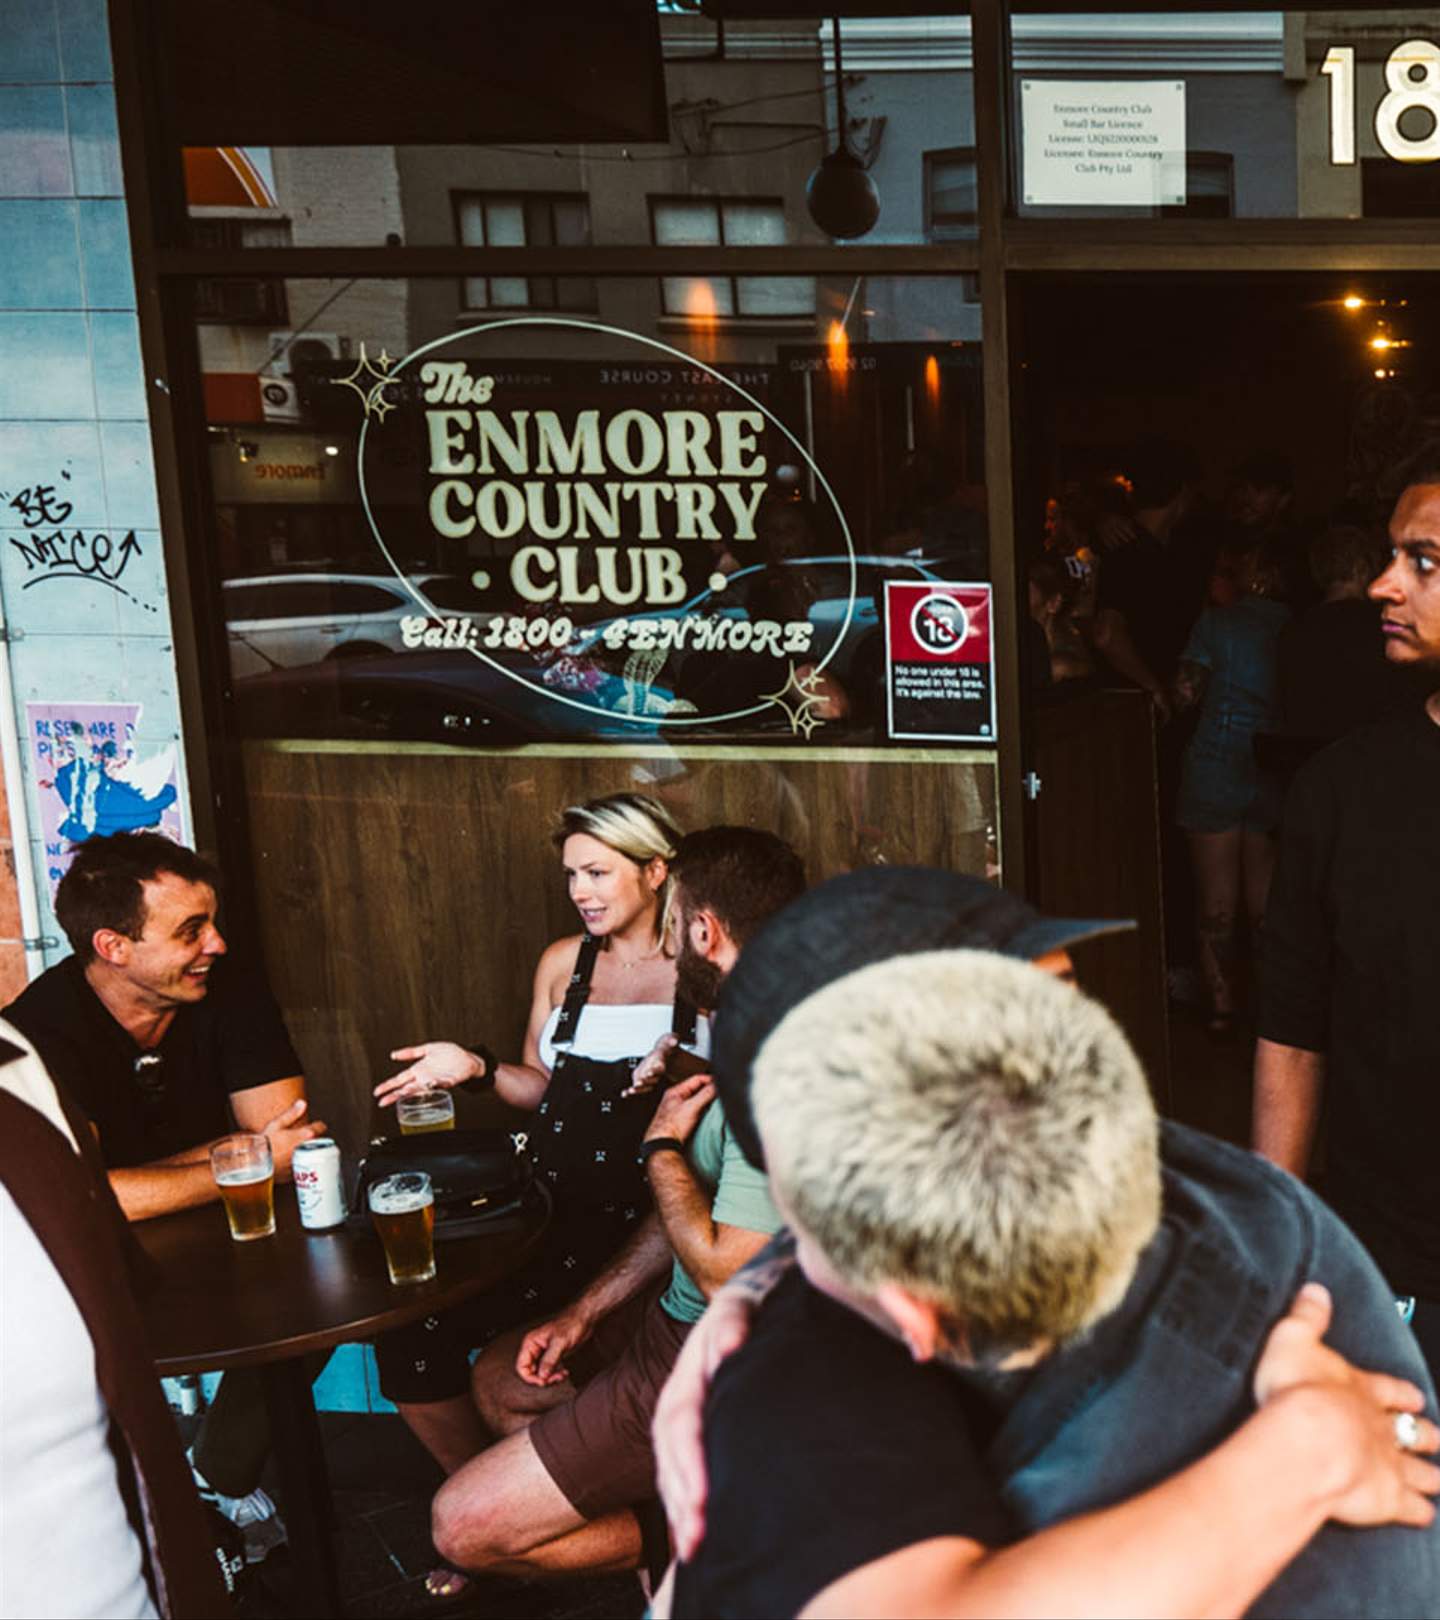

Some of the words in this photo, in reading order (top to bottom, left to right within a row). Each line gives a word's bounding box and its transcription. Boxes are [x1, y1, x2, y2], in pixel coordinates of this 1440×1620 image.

[1053, 104, 1088, 114] Enmore
[1091, 104, 1128, 115] Country
[1130, 104, 1152, 114] Club
[1063, 119, 1088, 129] Small
[1090, 119, 1105, 129] Bar
[1087, 149, 1122, 159] Enmore
[1125, 149, 1163, 161] Country
[1075, 163, 1096, 174] Club
[1098, 163, 1113, 175] Pty
[1116, 163, 1132, 174] Ltd
[420, 362, 494, 404] The
[425, 409, 768, 477] ENMORE
[429, 480, 768, 540] COUNTRY
[510, 546, 687, 605] CLUB
[400, 616, 478, 649] Call:
[483, 616, 573, 648] 1800
[602, 617, 815, 657] 4ENMORE
[895, 666, 909, 676] No
[911, 668, 928, 677] one
[930, 667, 957, 677] under
[971, 667, 980, 678] is
[895, 677, 931, 687] allowed
[933, 678, 941, 687] in
[943, 677, 960, 688] this
[962, 680, 985, 689] area.
[895, 687, 909, 697] It's
[911, 687, 945, 699] against
[946, 688, 961, 699] the
[963, 688, 982, 699] law.
